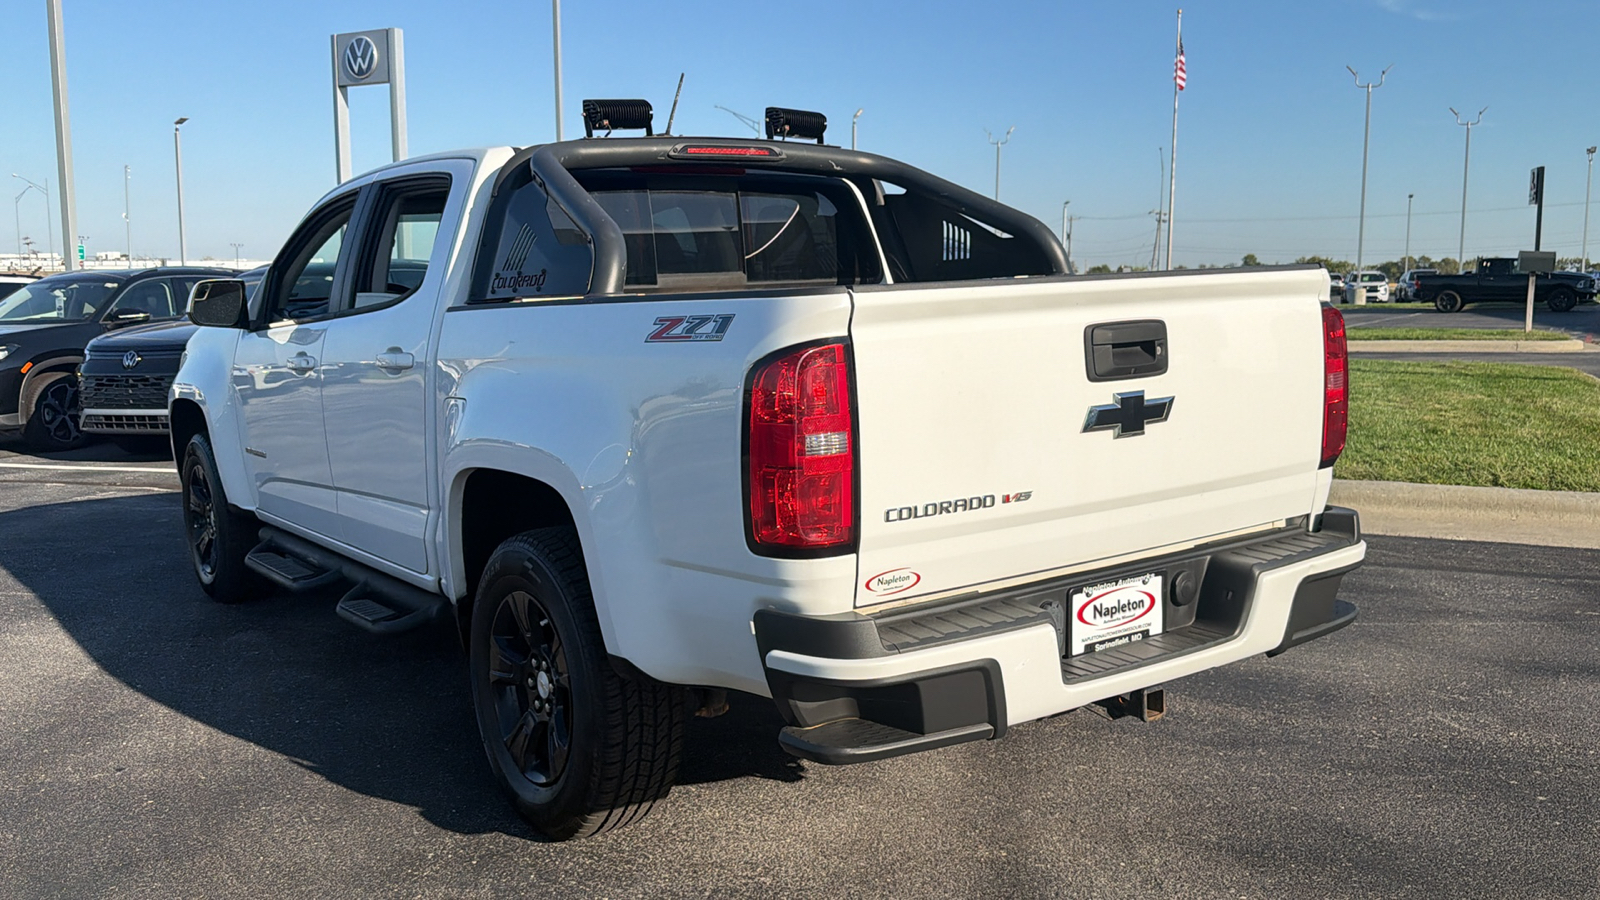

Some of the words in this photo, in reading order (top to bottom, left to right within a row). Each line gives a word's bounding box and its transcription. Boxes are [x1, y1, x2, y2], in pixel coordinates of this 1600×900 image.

[644, 314, 736, 343] Z71
[884, 494, 996, 523] COLORADO
[877, 575, 910, 586] Napleton
[1093, 599, 1145, 620] Napleton
